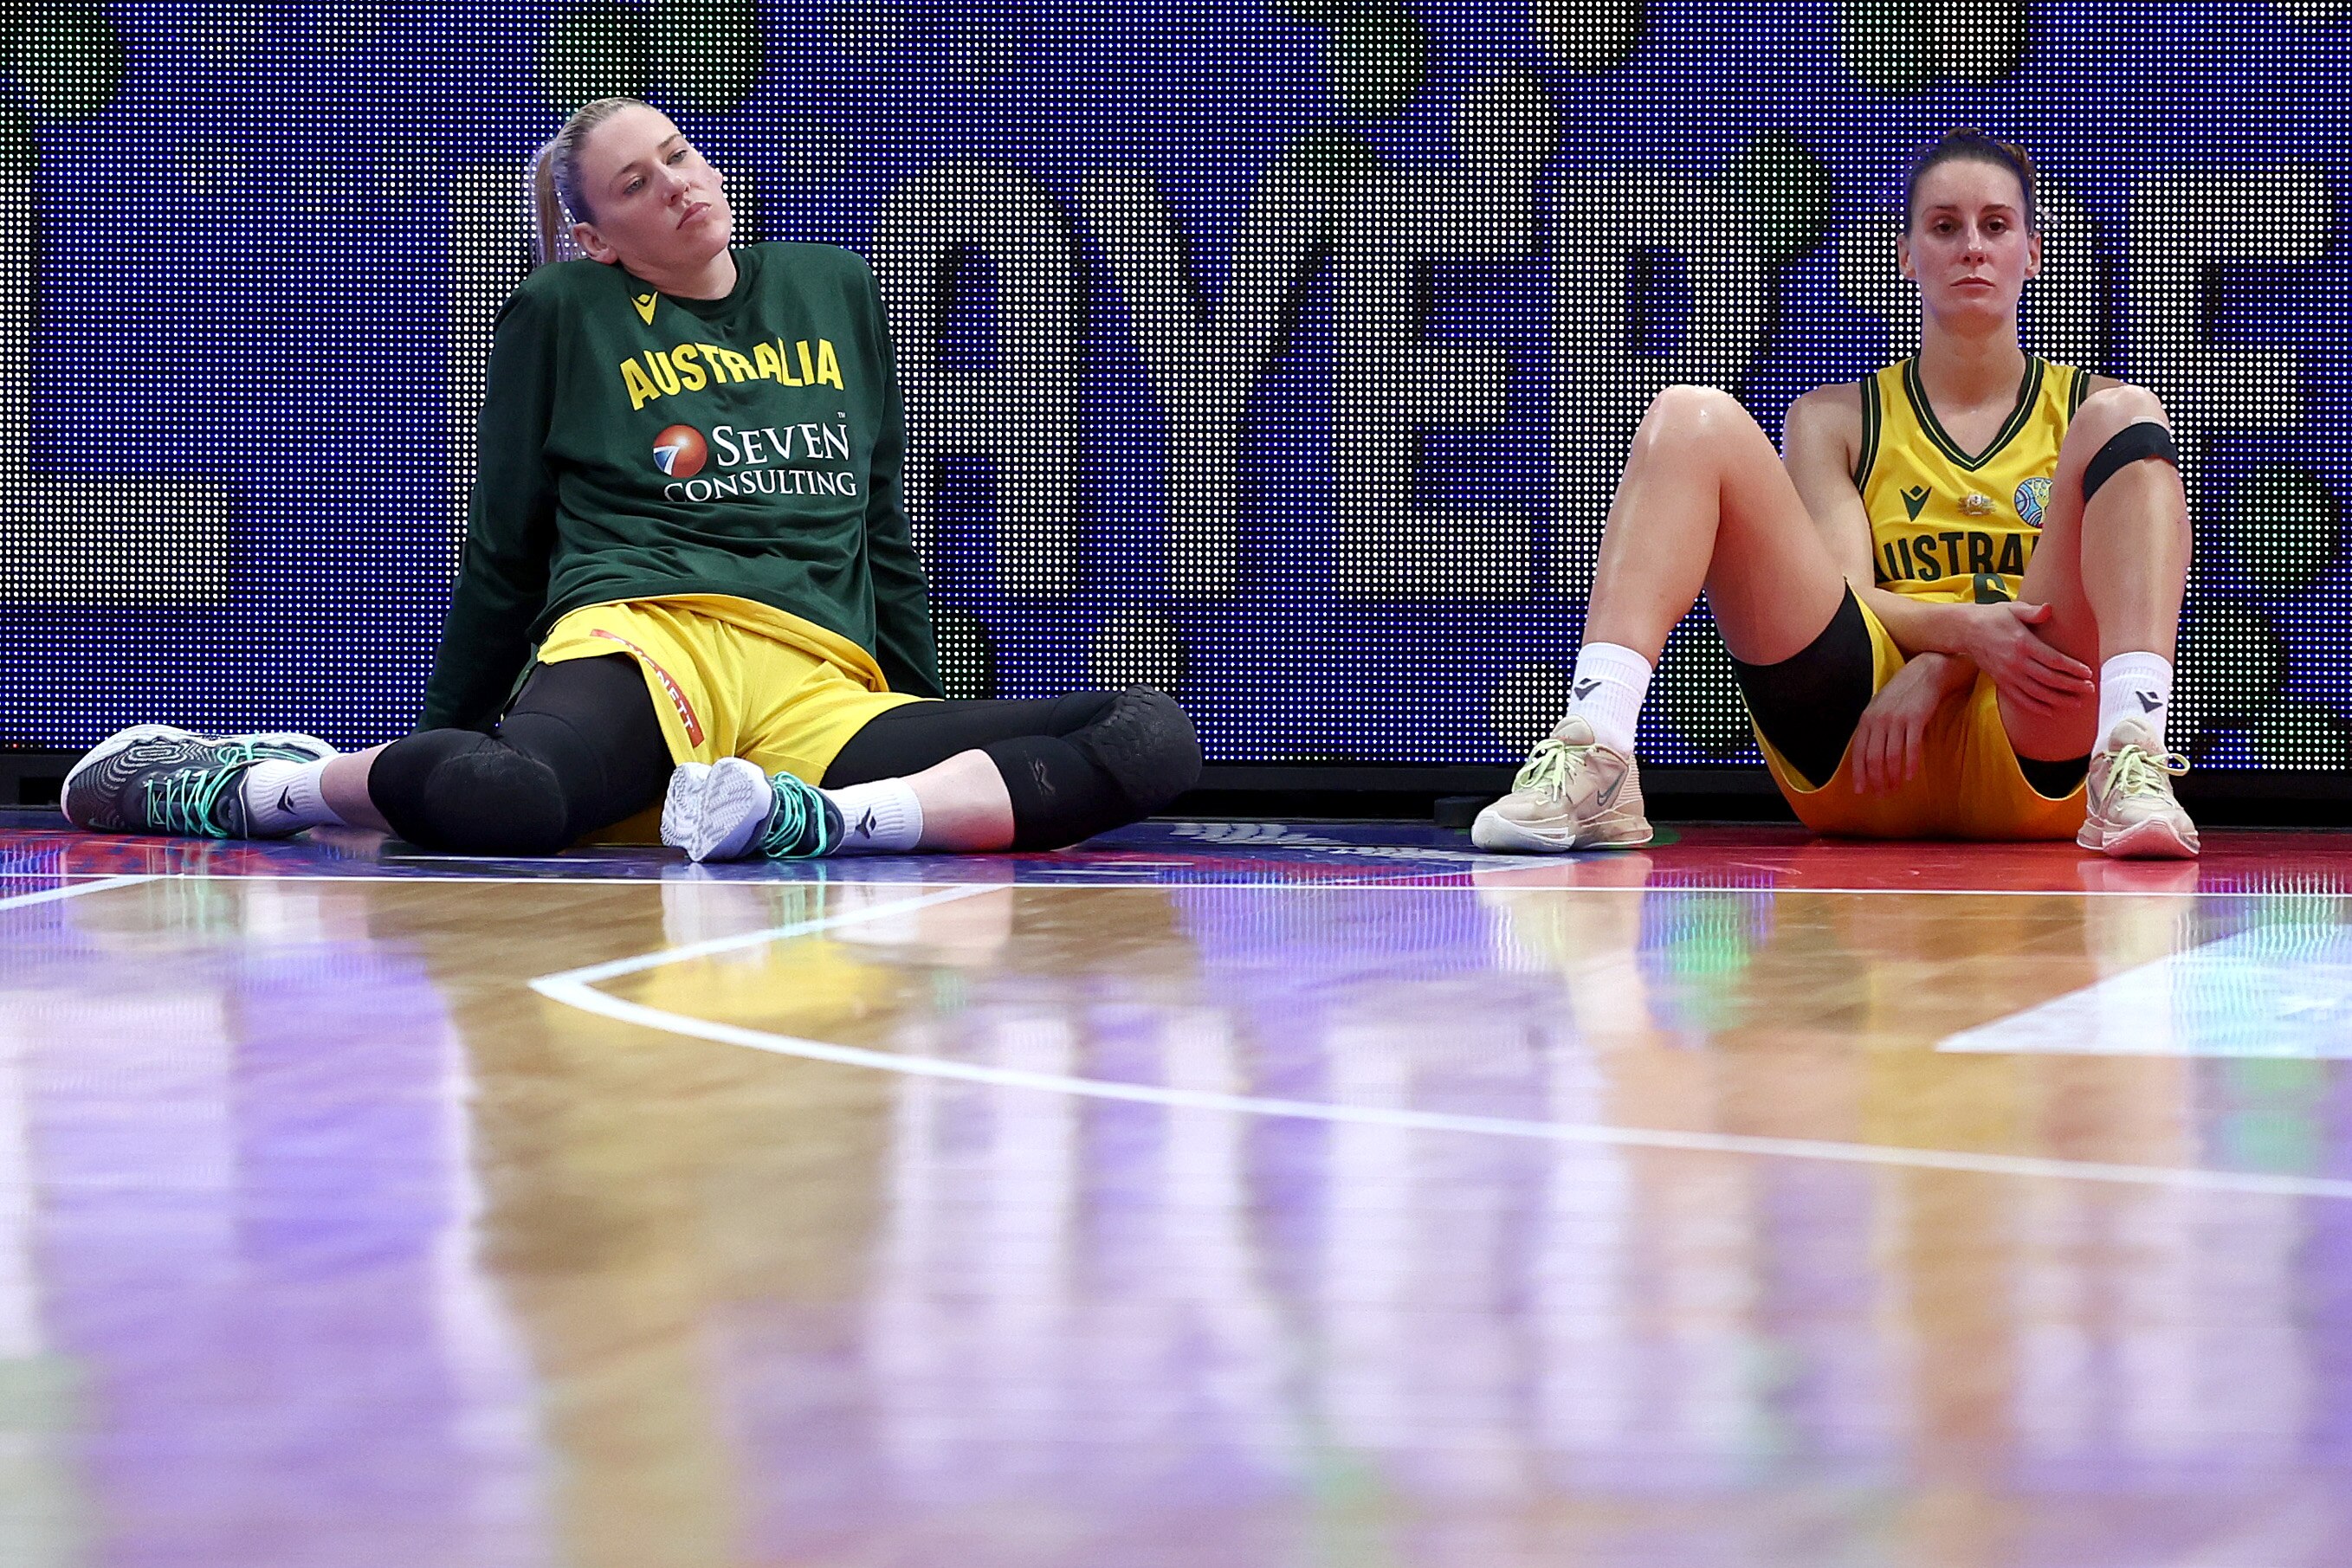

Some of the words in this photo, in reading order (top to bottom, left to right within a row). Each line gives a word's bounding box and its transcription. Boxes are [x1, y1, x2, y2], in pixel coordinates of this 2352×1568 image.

[450, 161, 1768, 599] AYER
[619, 338, 844, 411] AUSTRALIA
[712, 423, 850, 468] SEVEN
[664, 470, 856, 502] CONSULTING
